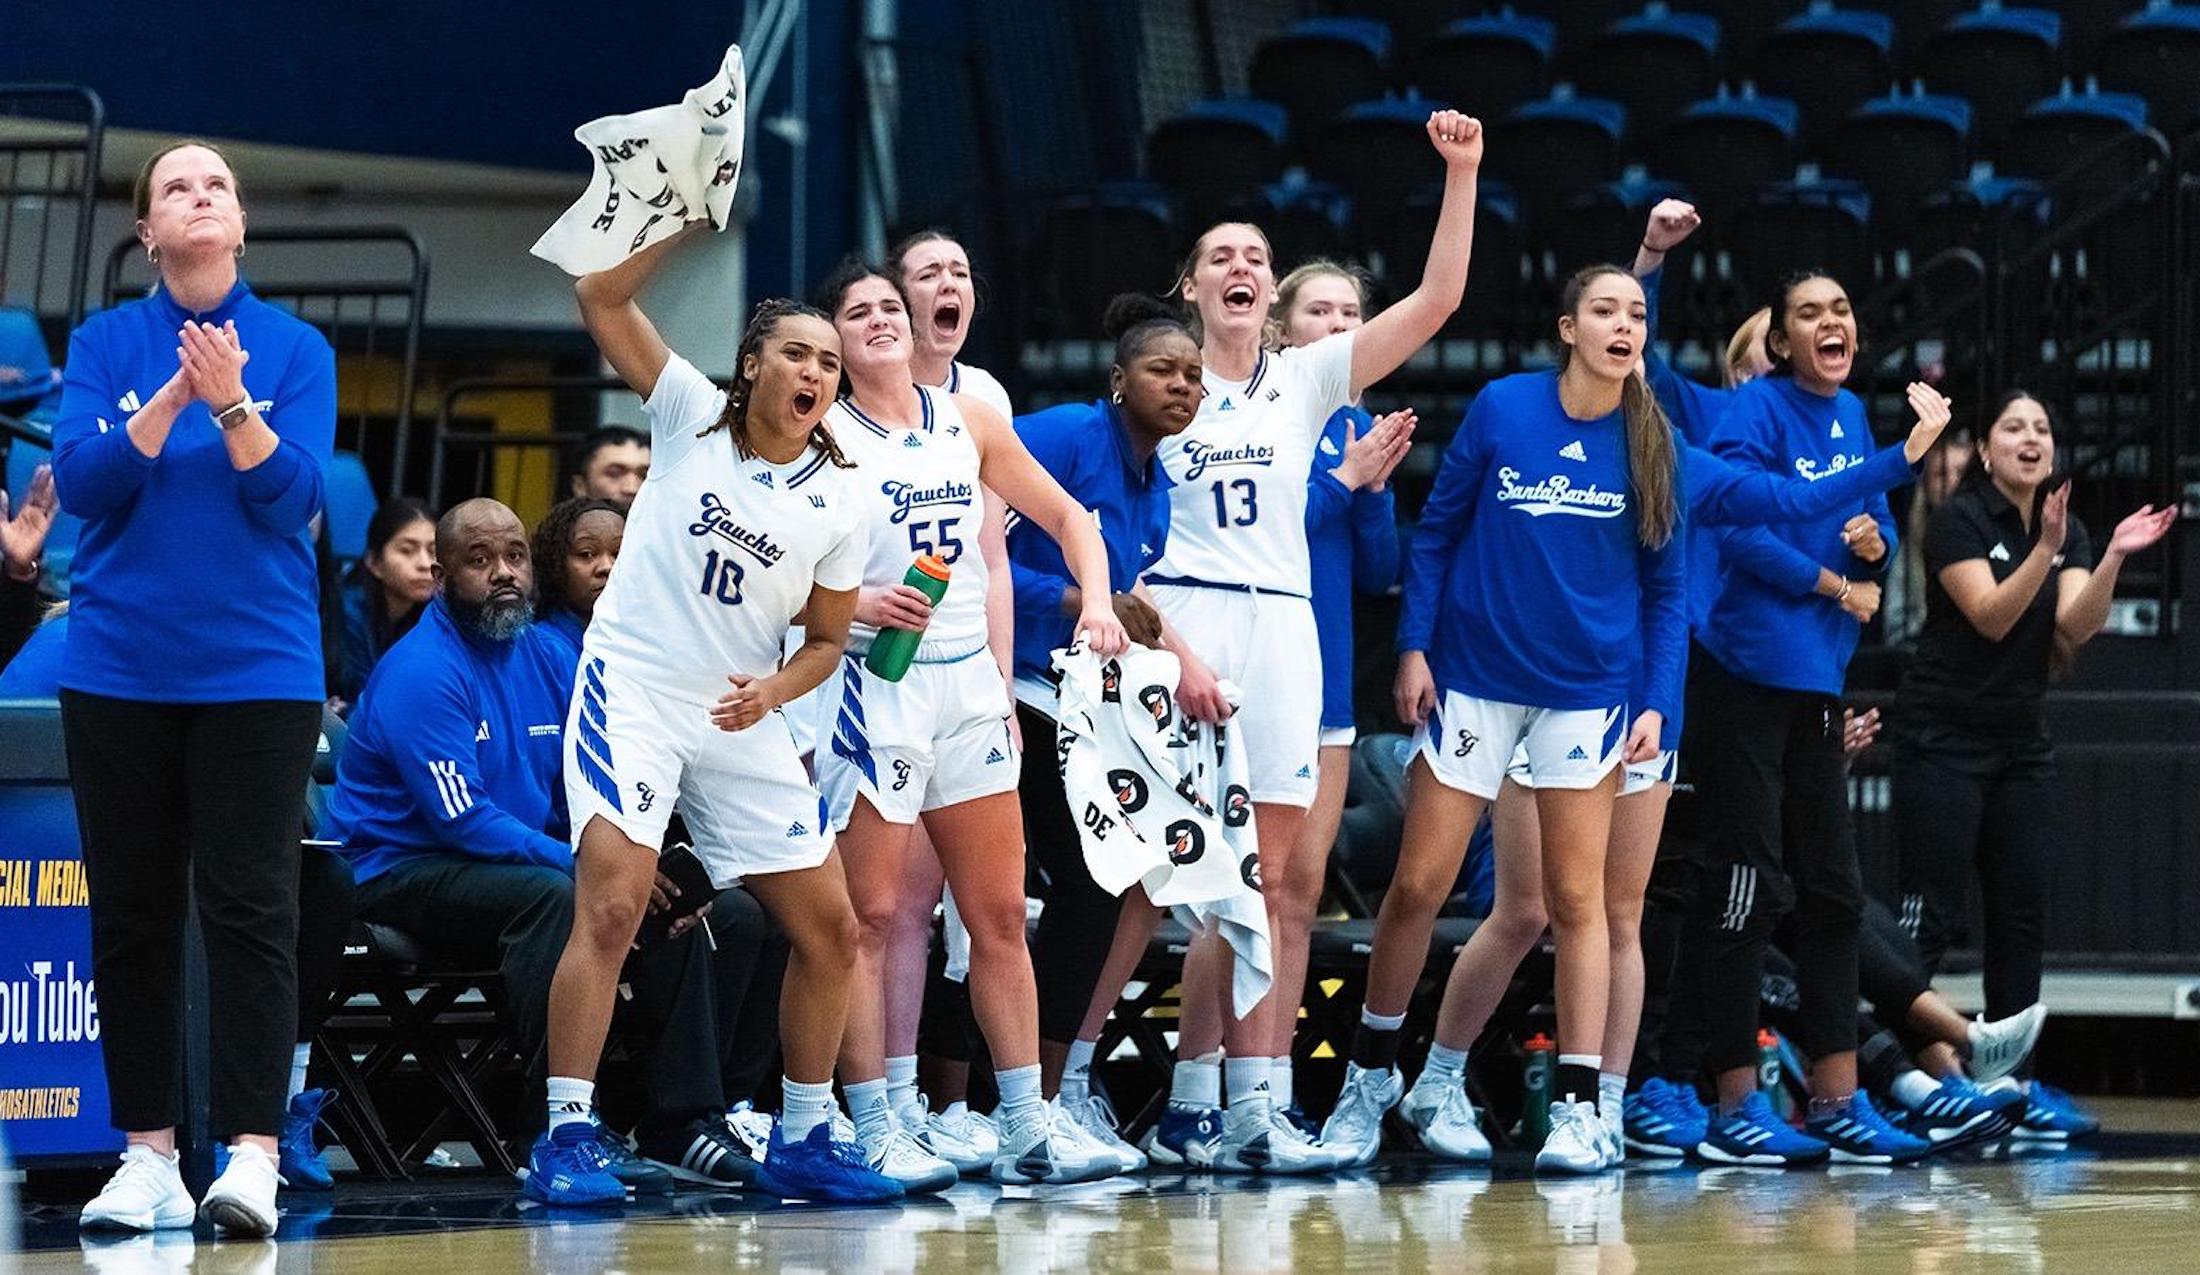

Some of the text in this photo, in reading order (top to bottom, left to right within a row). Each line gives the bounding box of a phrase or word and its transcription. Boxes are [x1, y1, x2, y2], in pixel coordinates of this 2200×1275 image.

[1182, 440, 1274, 481] Gauchos
[881, 480, 972, 524] Gauchos
[1211, 478, 1258, 528] 13
[689, 492, 786, 568] Gauchos
[909, 518, 963, 565] 55
[701, 548, 745, 605] 10
[36, 860, 89, 906] MEDIA
